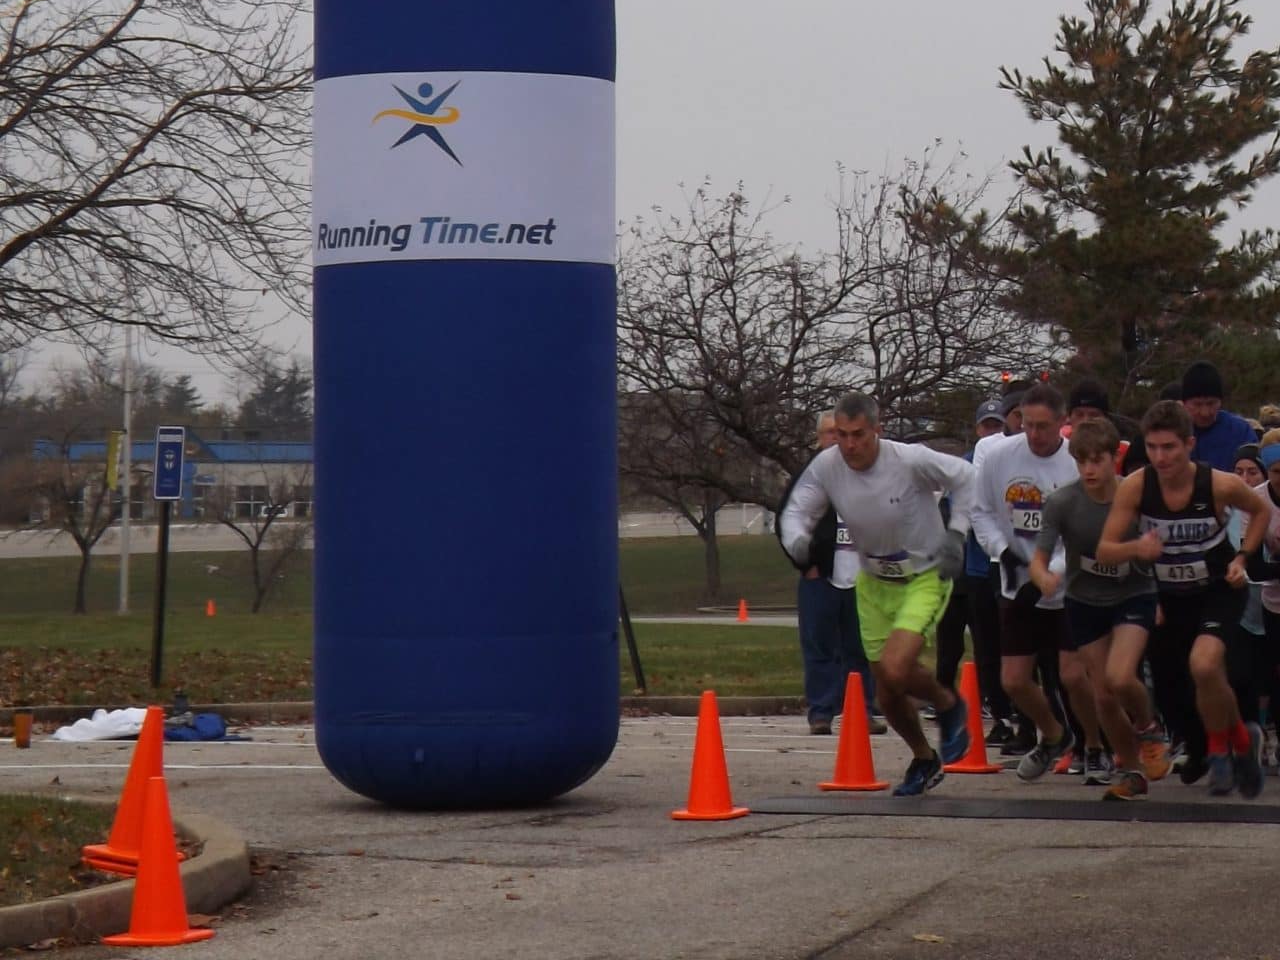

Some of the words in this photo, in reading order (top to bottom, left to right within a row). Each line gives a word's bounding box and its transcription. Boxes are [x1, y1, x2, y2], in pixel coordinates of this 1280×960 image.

[317, 219, 411, 251] Running
[420, 217, 556, 245] Time.net
[1168, 565, 1196, 579] 473
